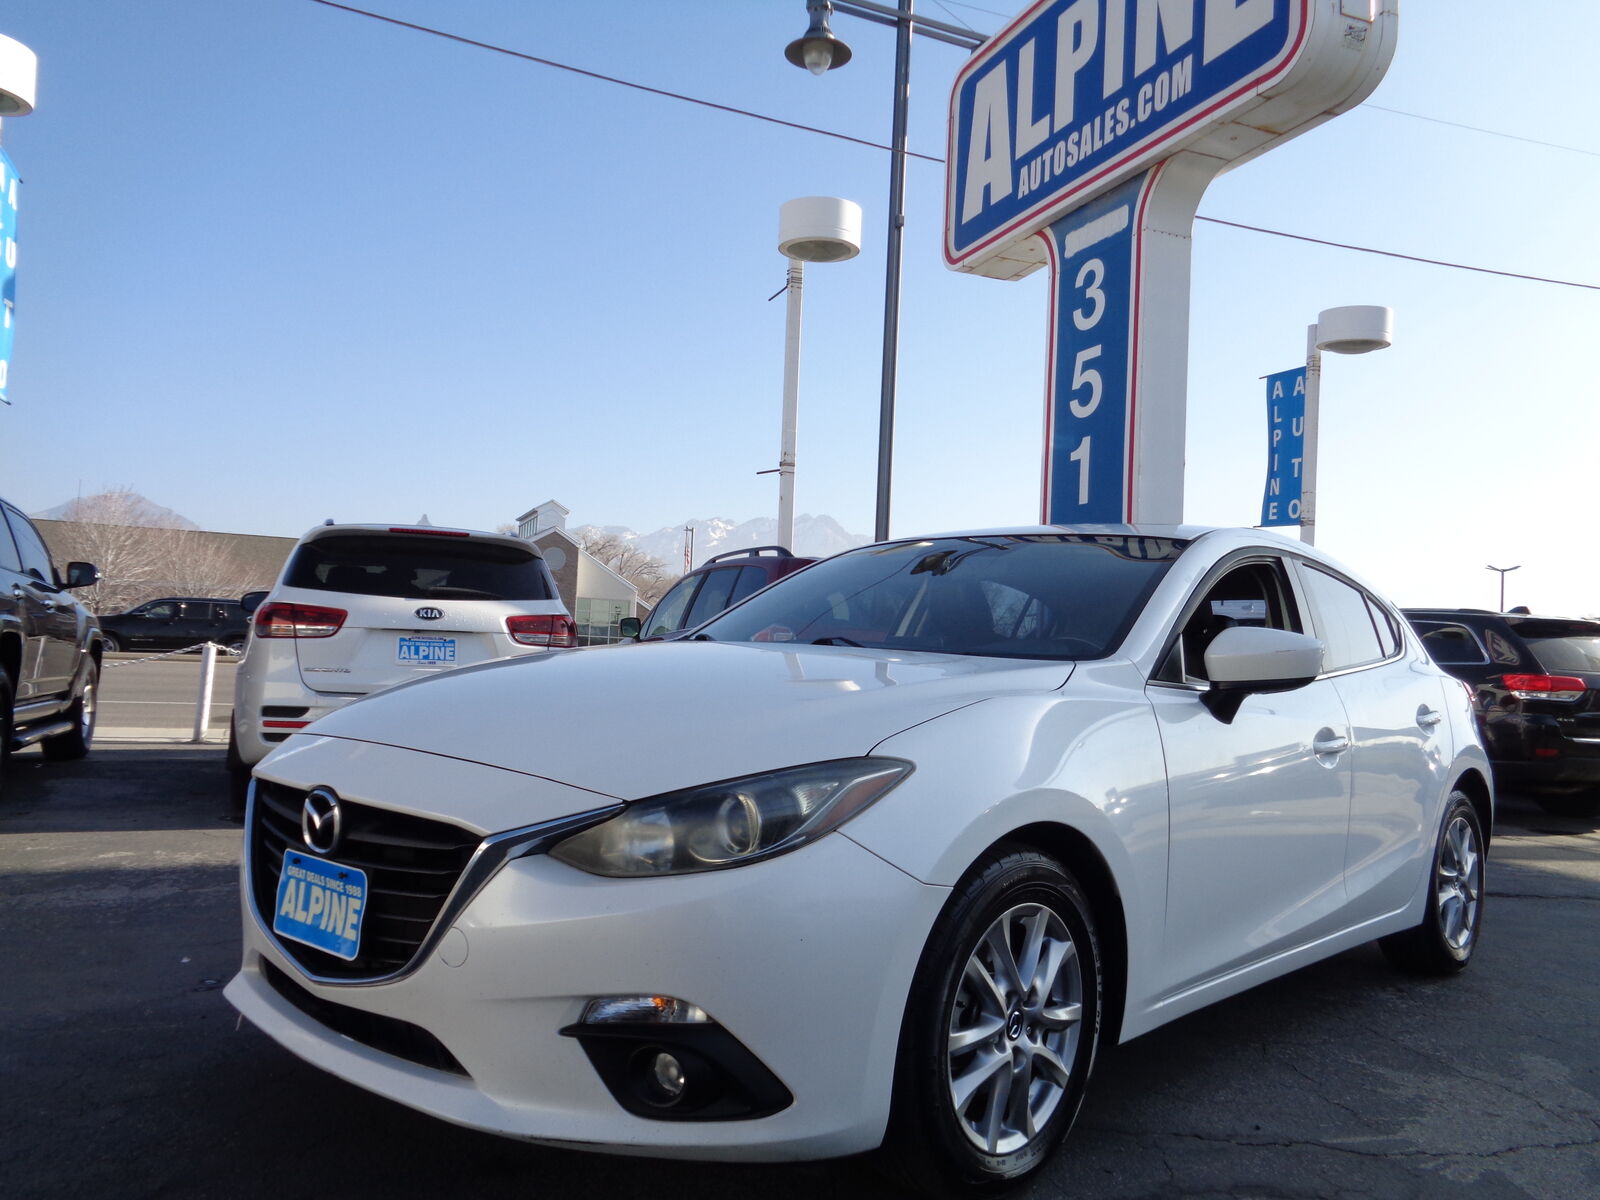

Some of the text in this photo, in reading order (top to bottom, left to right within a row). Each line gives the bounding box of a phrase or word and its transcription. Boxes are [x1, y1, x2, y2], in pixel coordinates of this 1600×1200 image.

[1017, 54, 1193, 200] AUTOSALES.COM
[1268, 380, 1284, 520] ALPINE
[1288, 375, 1305, 519] AUTO
[399, 645, 456, 661] ALPINE
[419, 609, 440, 618] KIA
[280, 879, 361, 941] ALPINE
